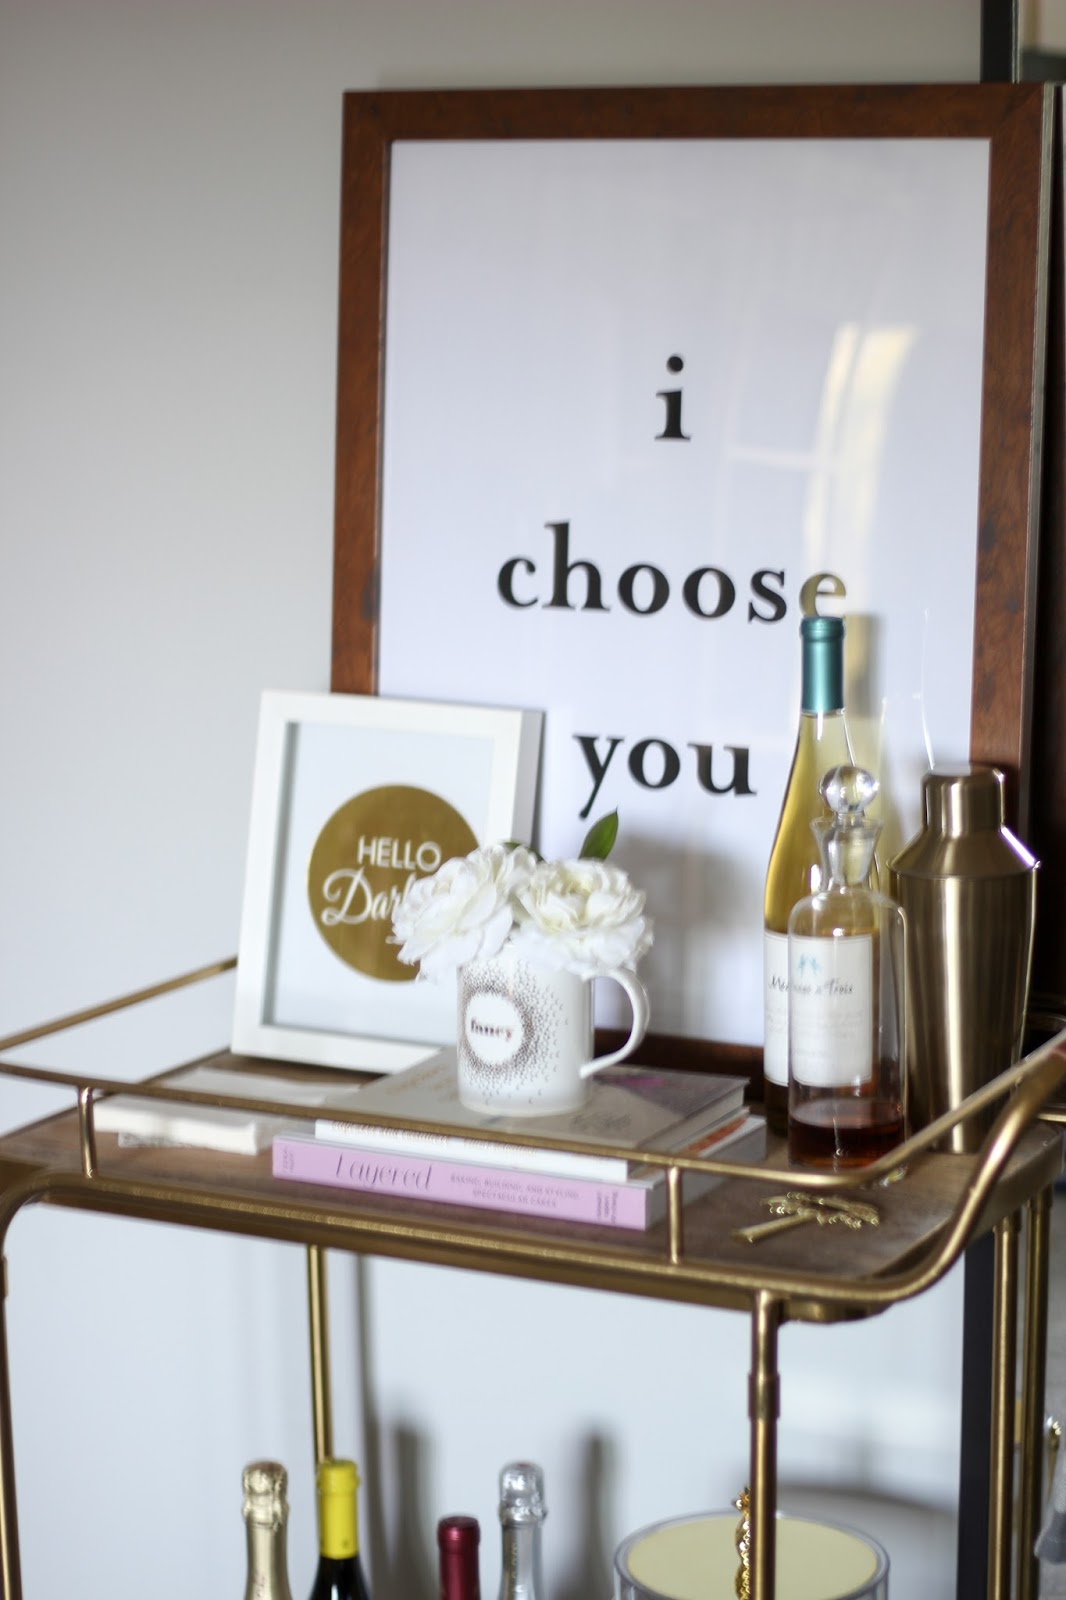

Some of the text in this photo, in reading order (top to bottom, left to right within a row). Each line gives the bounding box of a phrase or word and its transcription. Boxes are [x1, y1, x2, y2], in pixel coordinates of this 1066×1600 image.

[654, 353, 691, 441] i
[497, 519, 847, 624] choose
[572, 732, 757, 820] you
[357, 835, 442, 873] HELLO
[321, 866, 417, 926] Darl
[336, 1152, 433, 1190] Layered
